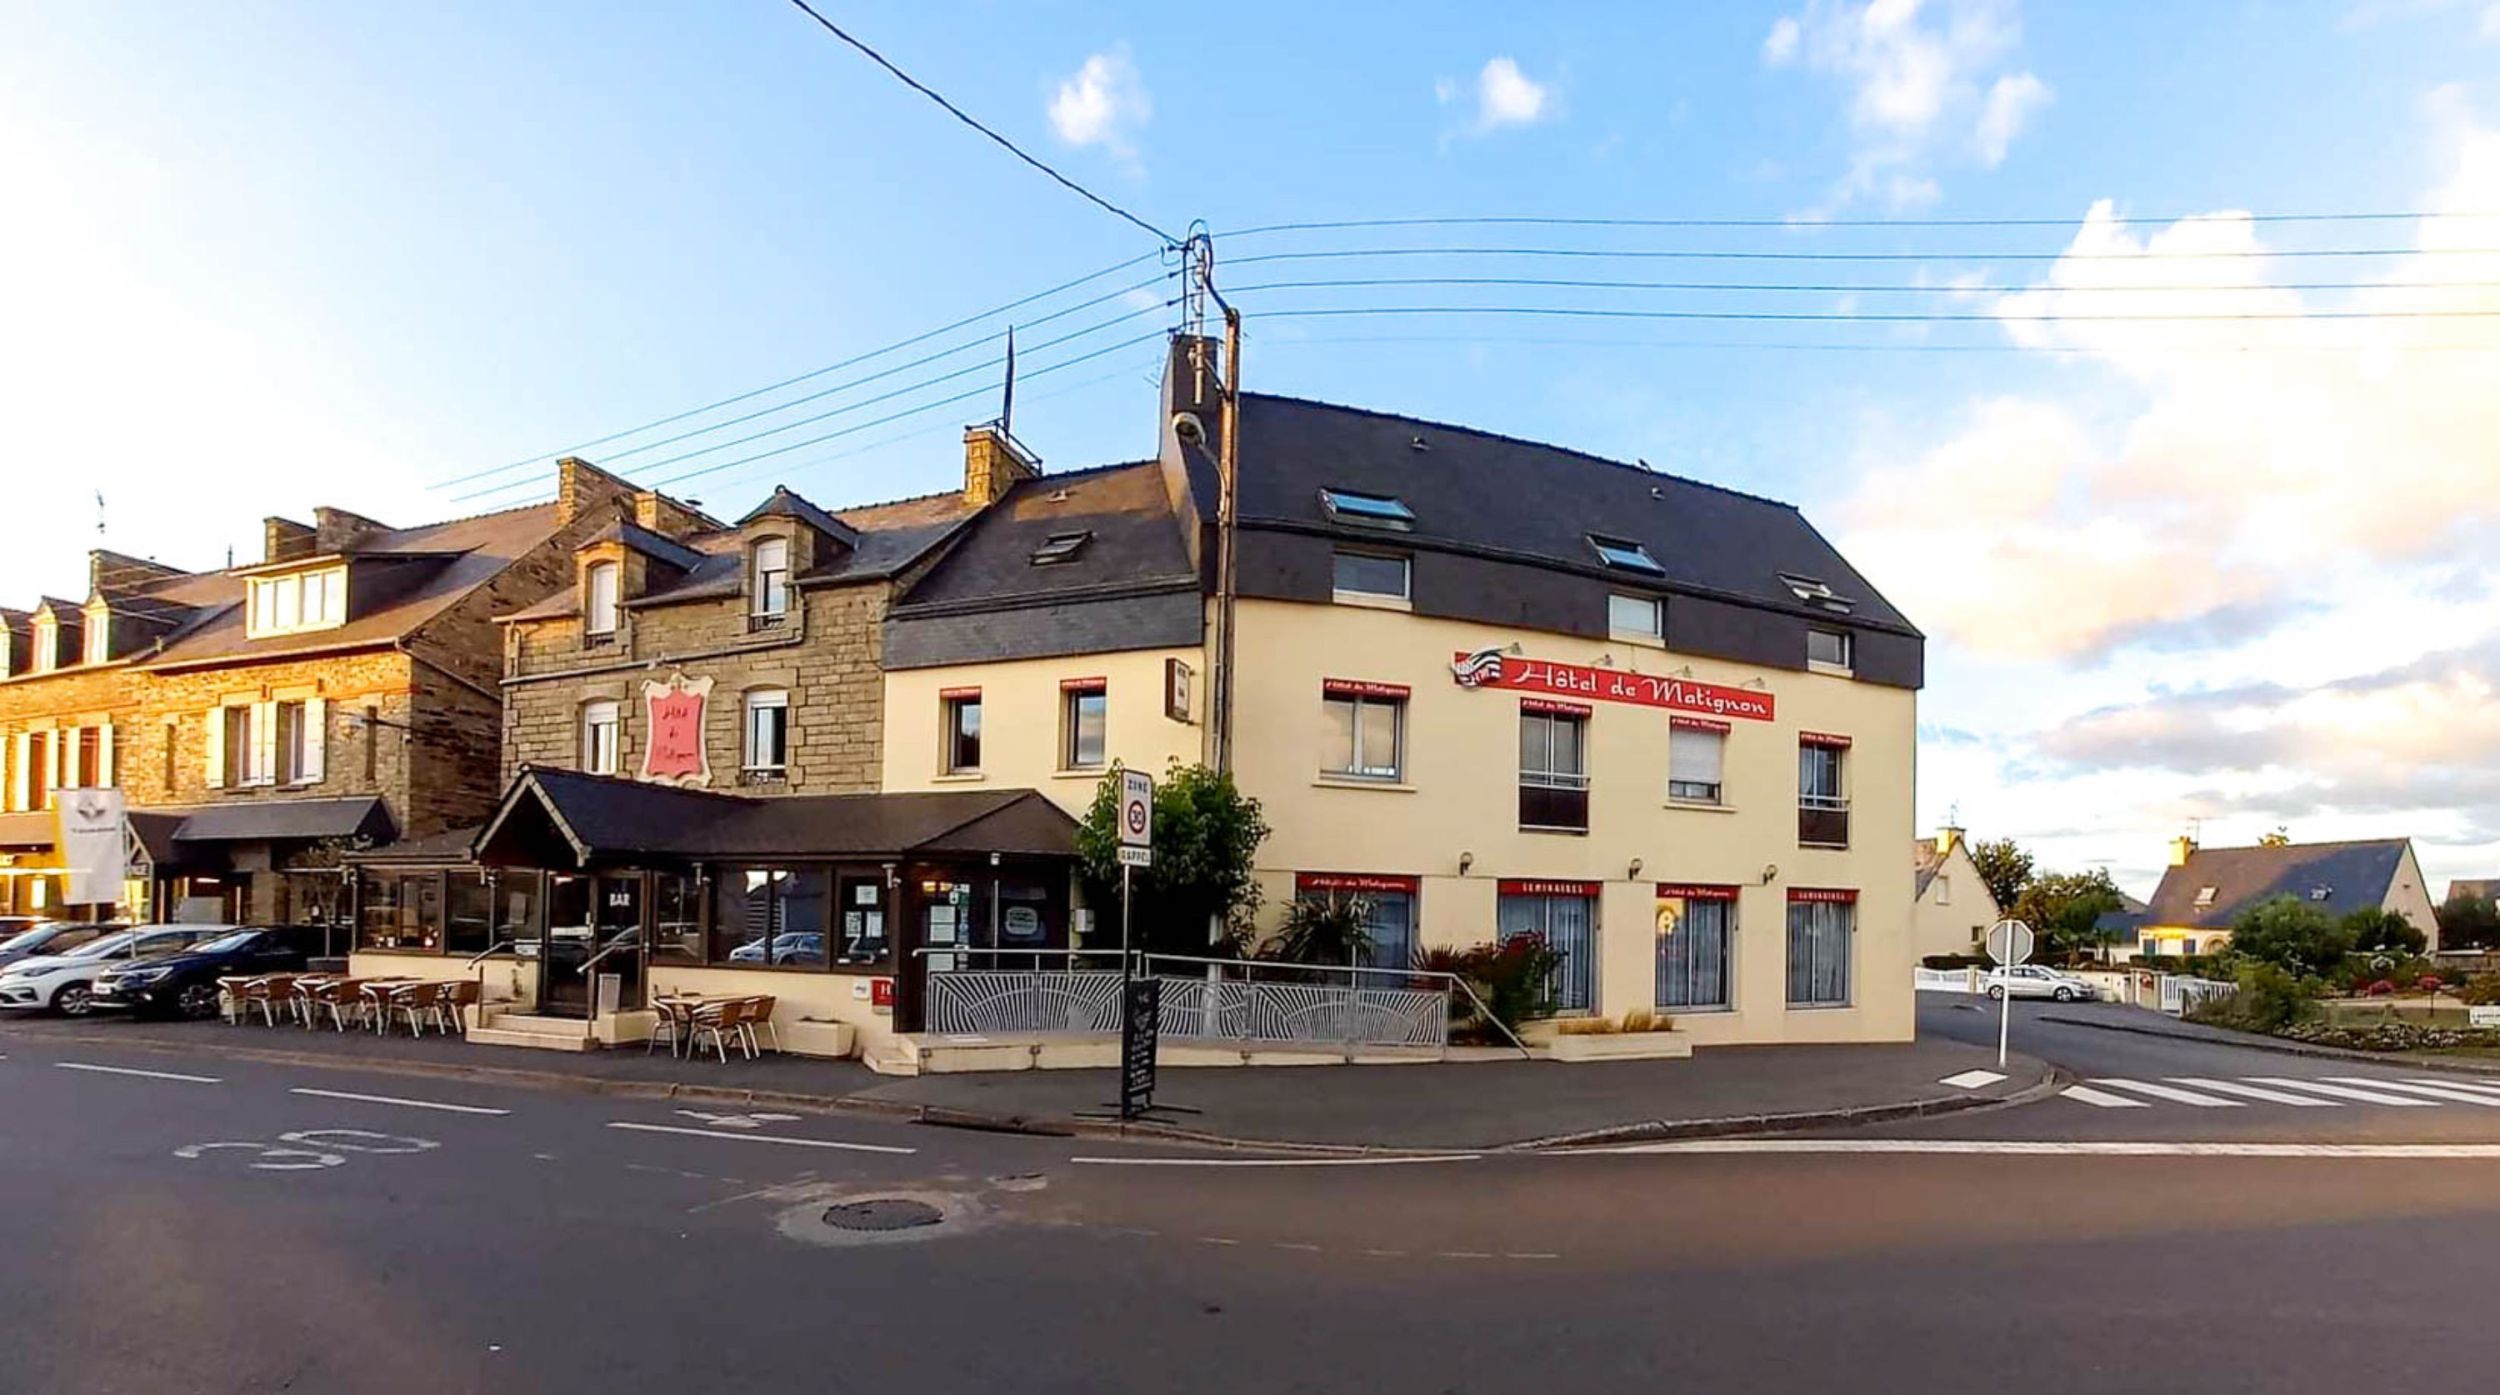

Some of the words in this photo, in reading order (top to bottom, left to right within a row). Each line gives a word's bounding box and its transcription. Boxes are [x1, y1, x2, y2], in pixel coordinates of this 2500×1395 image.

[1512, 663, 1597, 692] Hôtel
[1611, 677, 1636, 696] de
[1641, 679, 1767, 714] Matignon
[1131, 809, 1142, 826] 30
[610, 893, 630, 906] BAR
